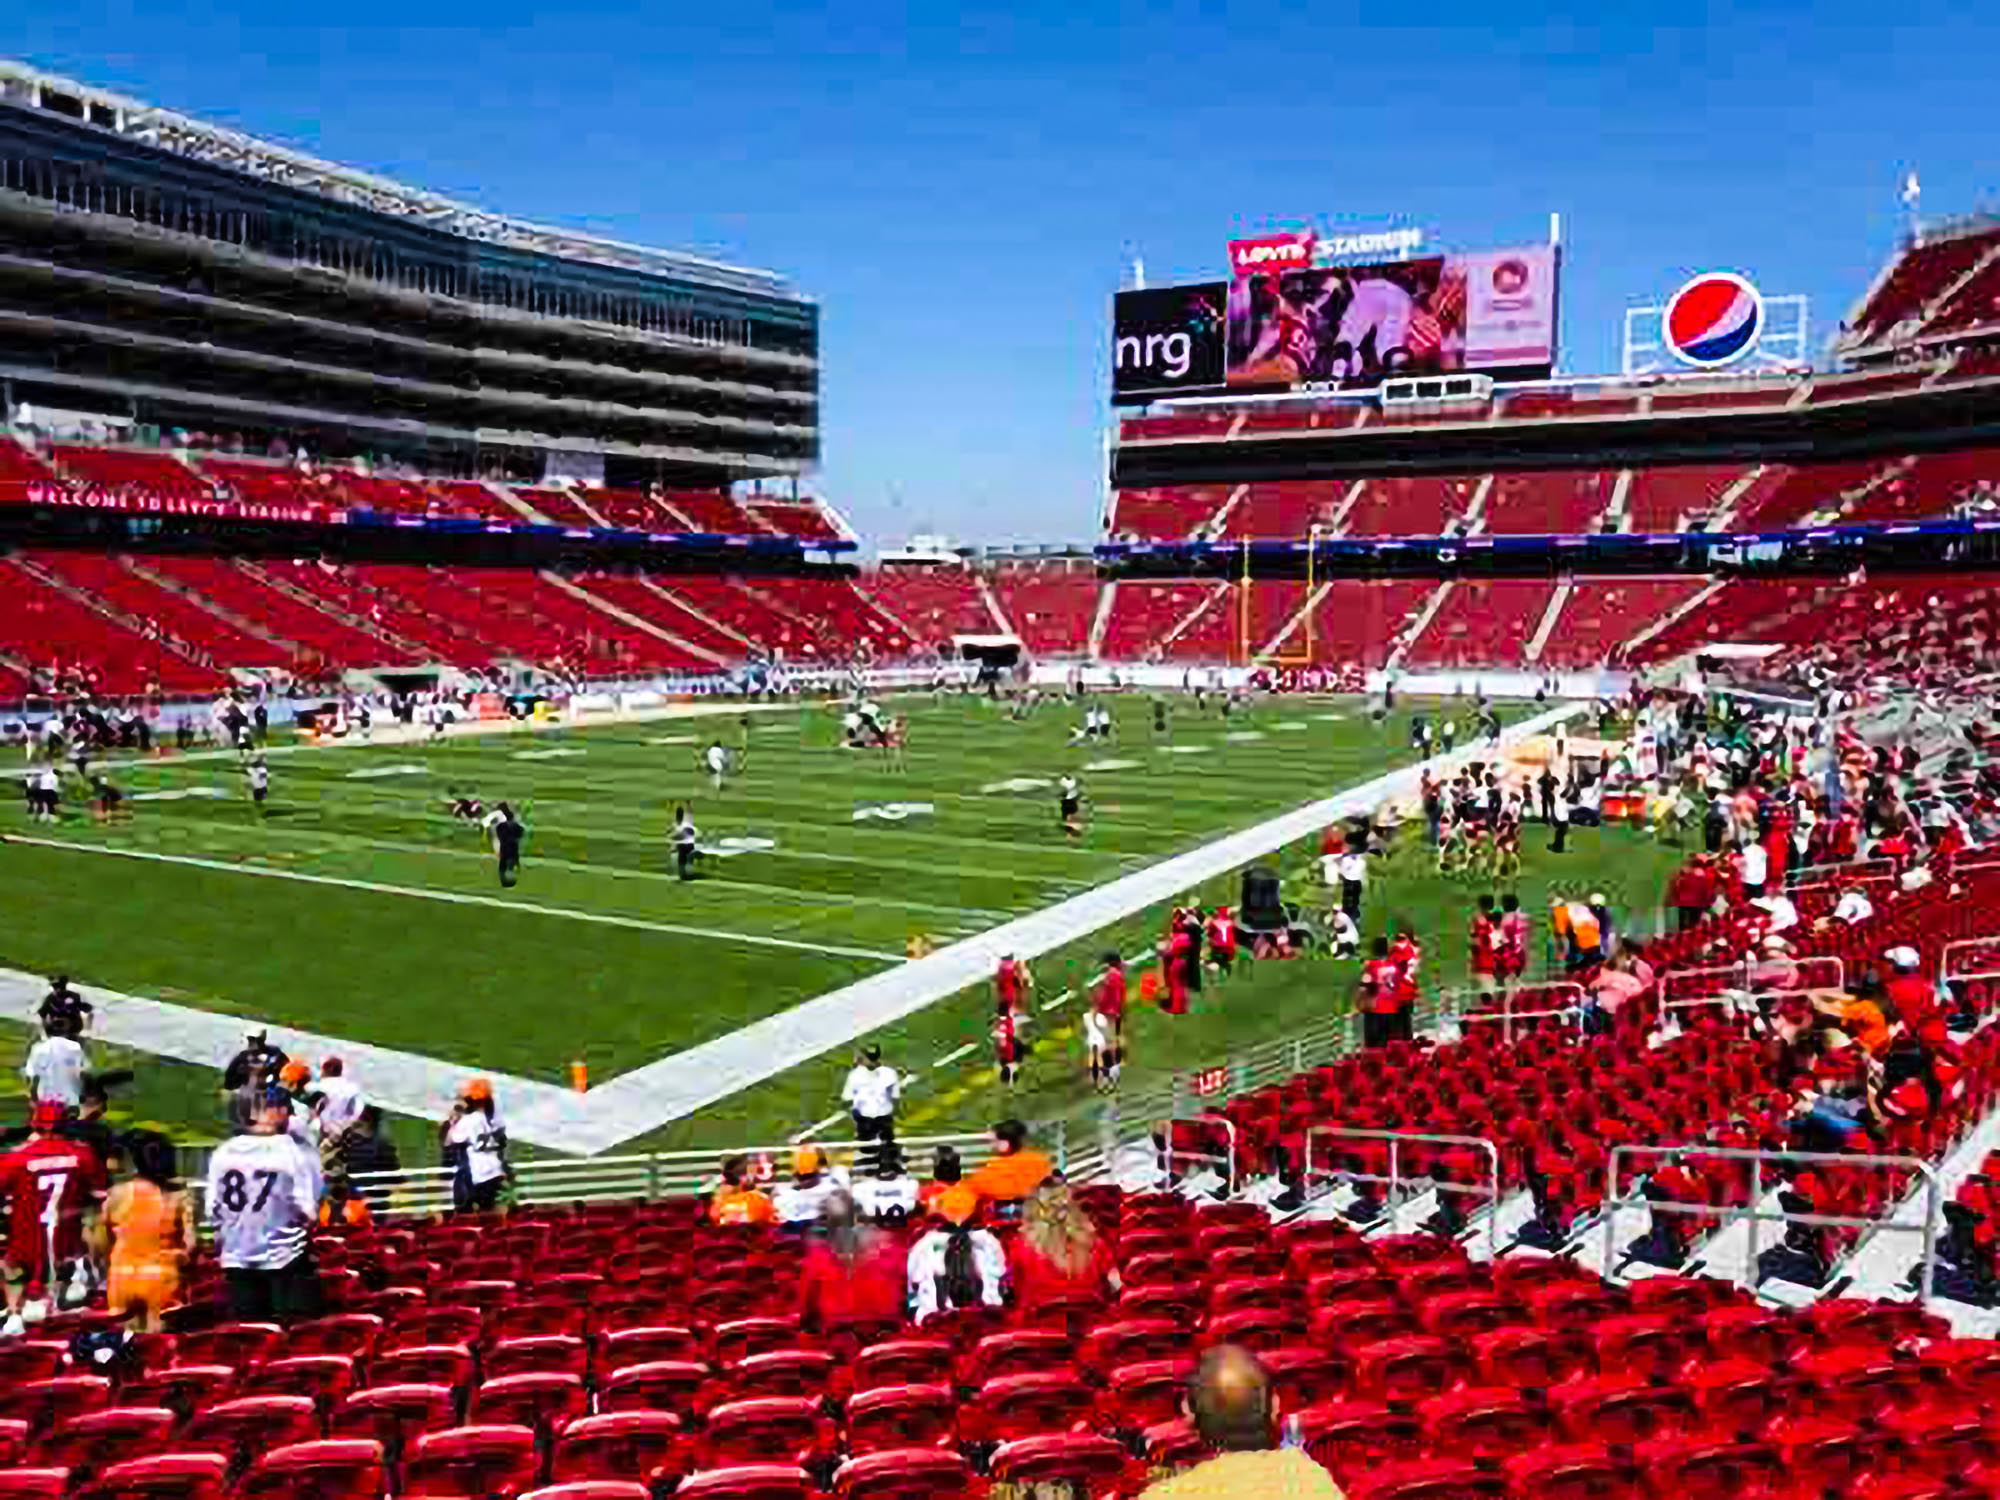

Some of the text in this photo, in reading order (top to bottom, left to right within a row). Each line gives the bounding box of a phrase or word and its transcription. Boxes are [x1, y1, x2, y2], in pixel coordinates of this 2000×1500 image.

[1115, 332, 1192, 378] nrg
[37, 1173, 67, 1223] 7
[222, 1168, 278, 1213] 87
